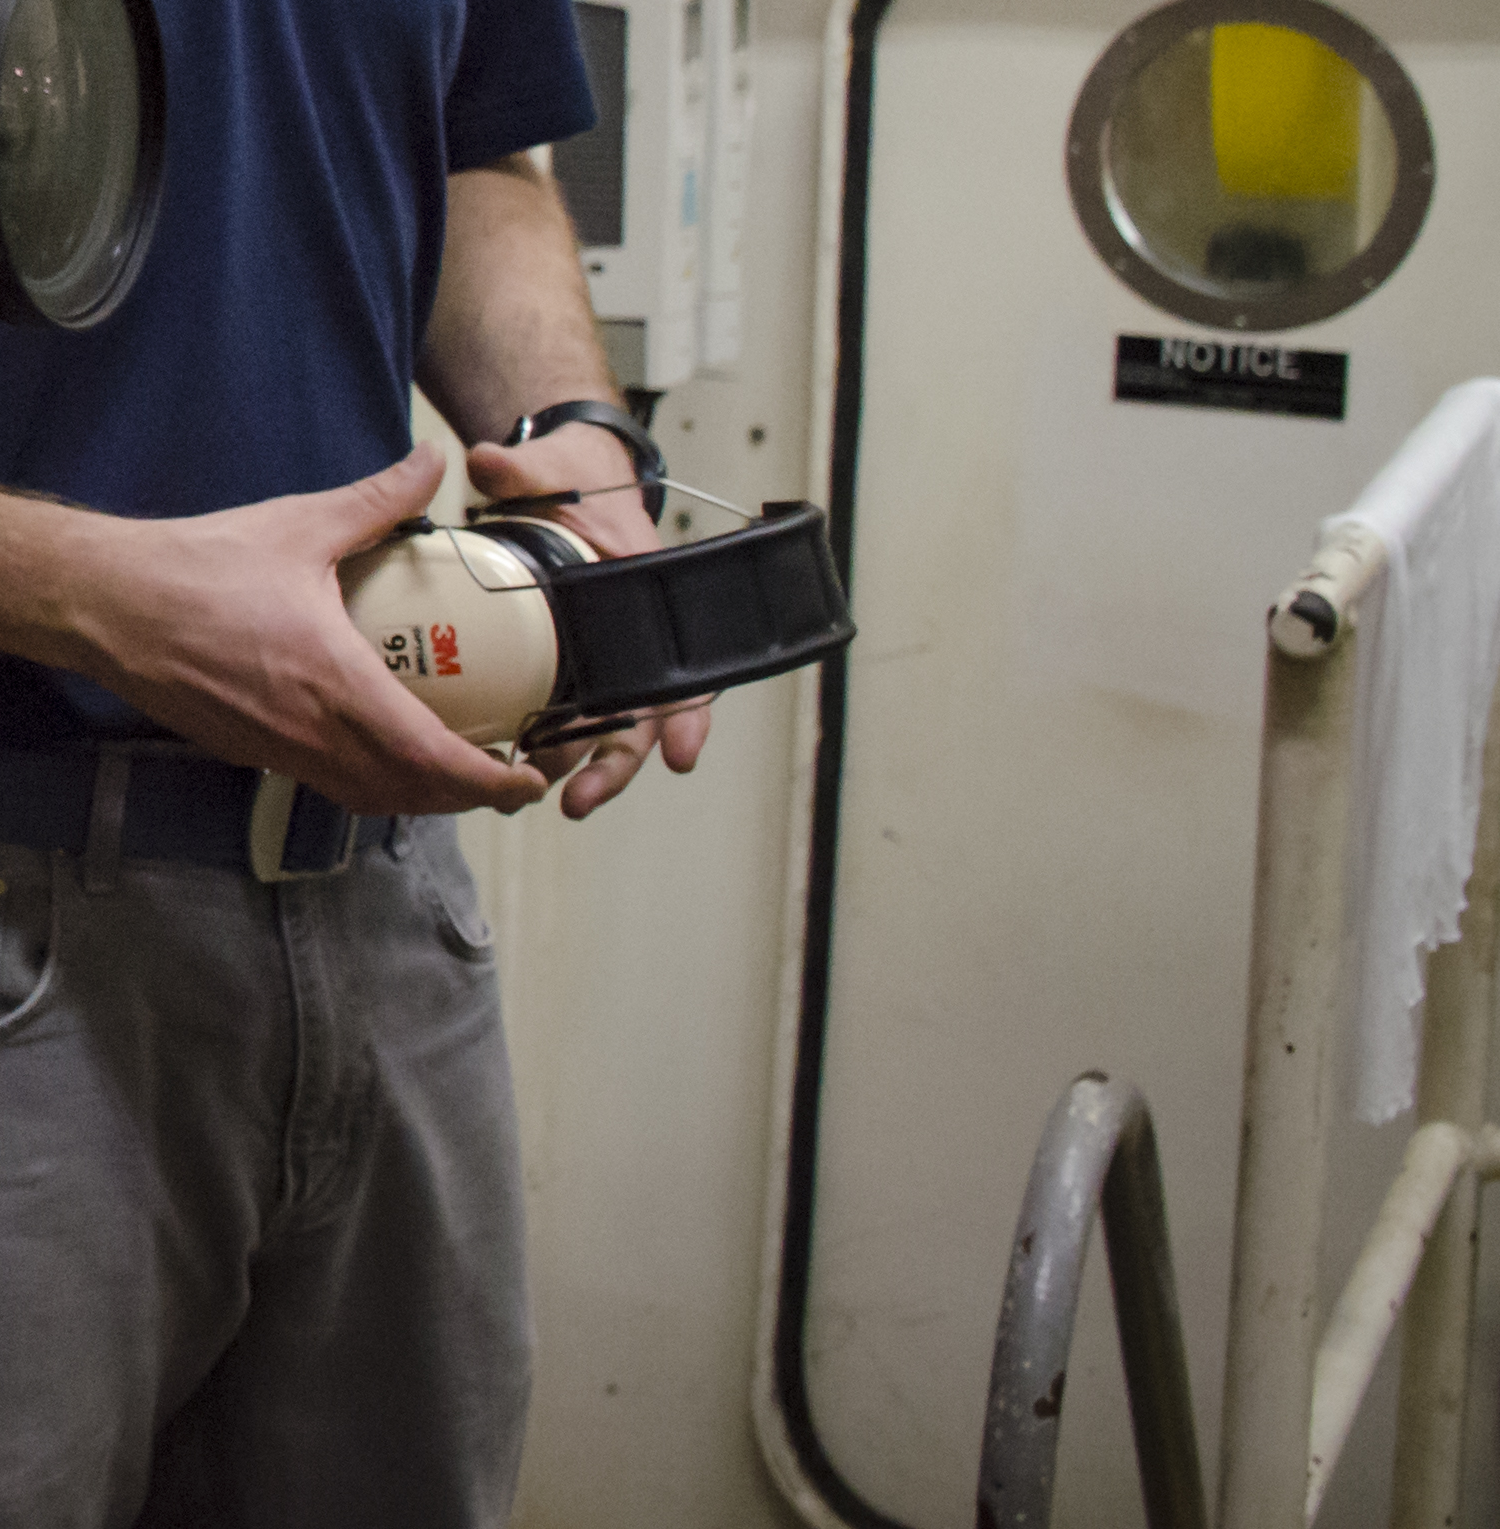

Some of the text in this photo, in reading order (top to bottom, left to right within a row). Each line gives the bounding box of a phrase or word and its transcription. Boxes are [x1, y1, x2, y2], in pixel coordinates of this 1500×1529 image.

[1159, 339, 1299, 381] NOTICE
[382, 633, 410, 672] 95
[429, 622, 462, 677] 3M
